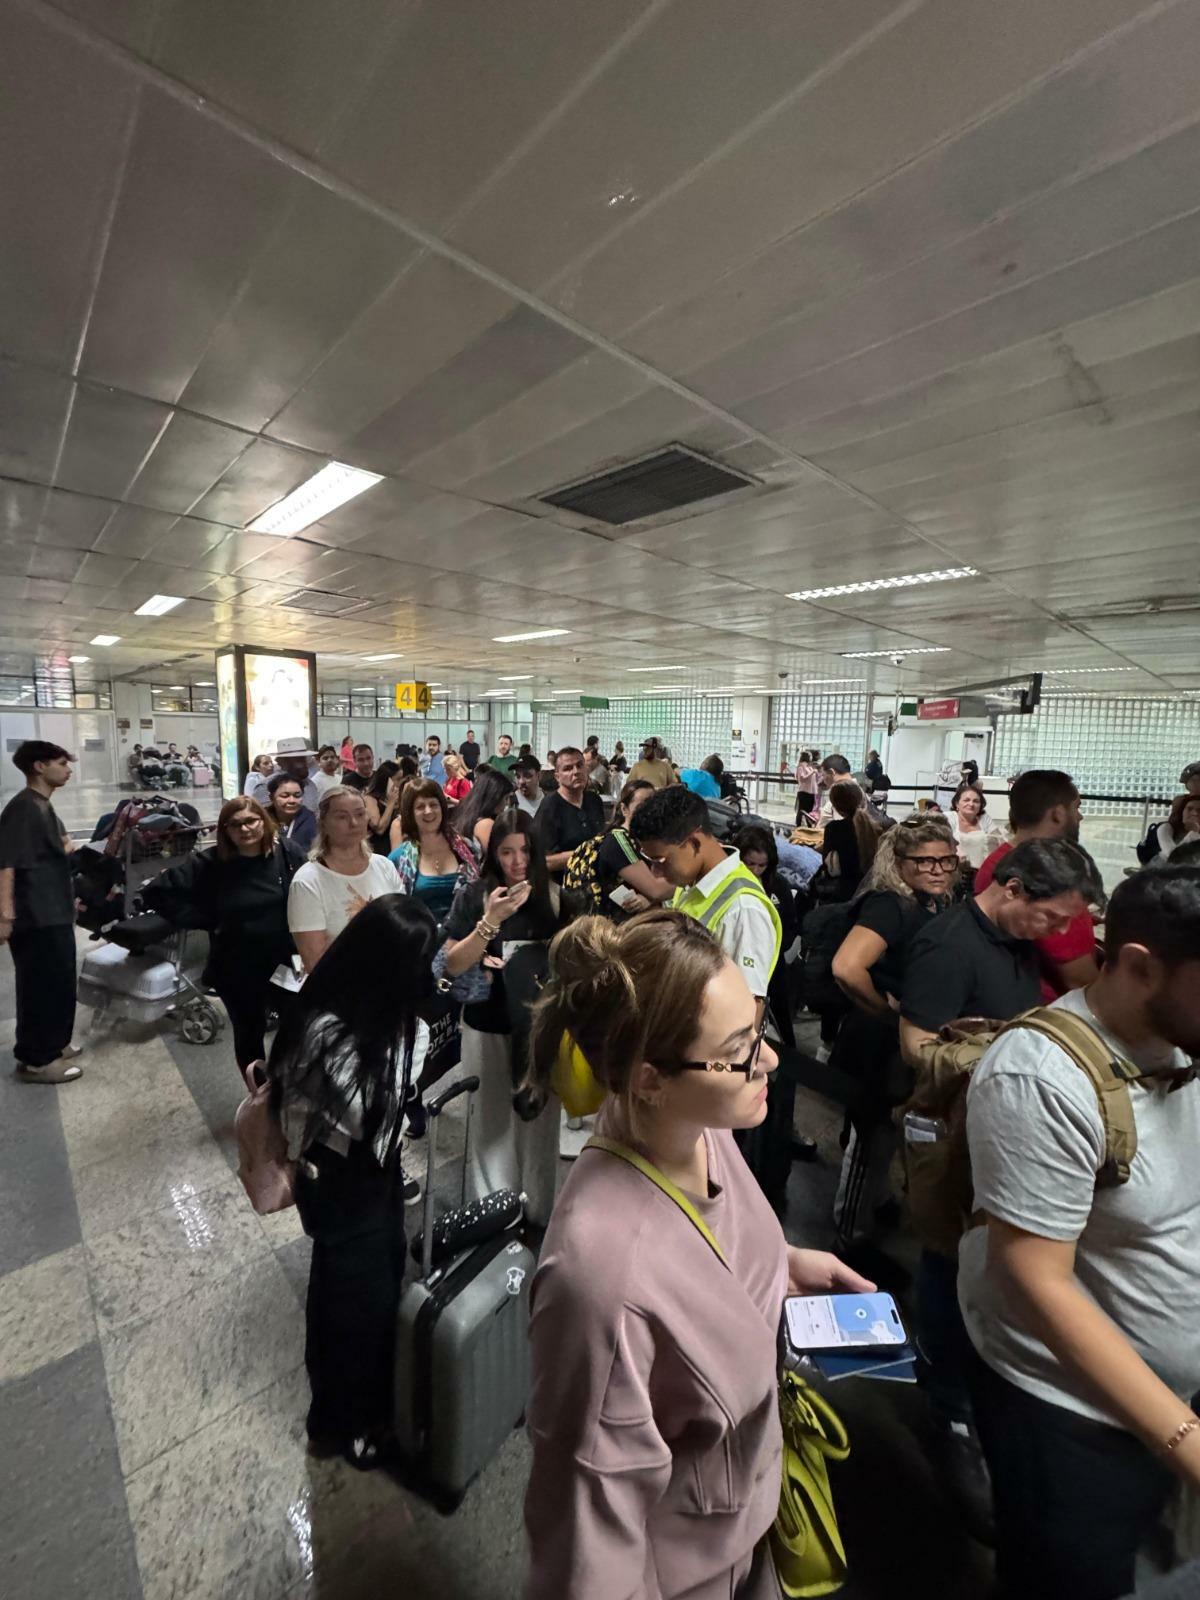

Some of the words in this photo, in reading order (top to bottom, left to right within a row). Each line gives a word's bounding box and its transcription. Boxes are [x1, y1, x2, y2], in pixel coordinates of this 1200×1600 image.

[400, 686, 412, 706] 4
[418, 687, 429, 707] 4
[431, 1012, 451, 1034] THE
[427, 1032, 445, 1055] OTE
